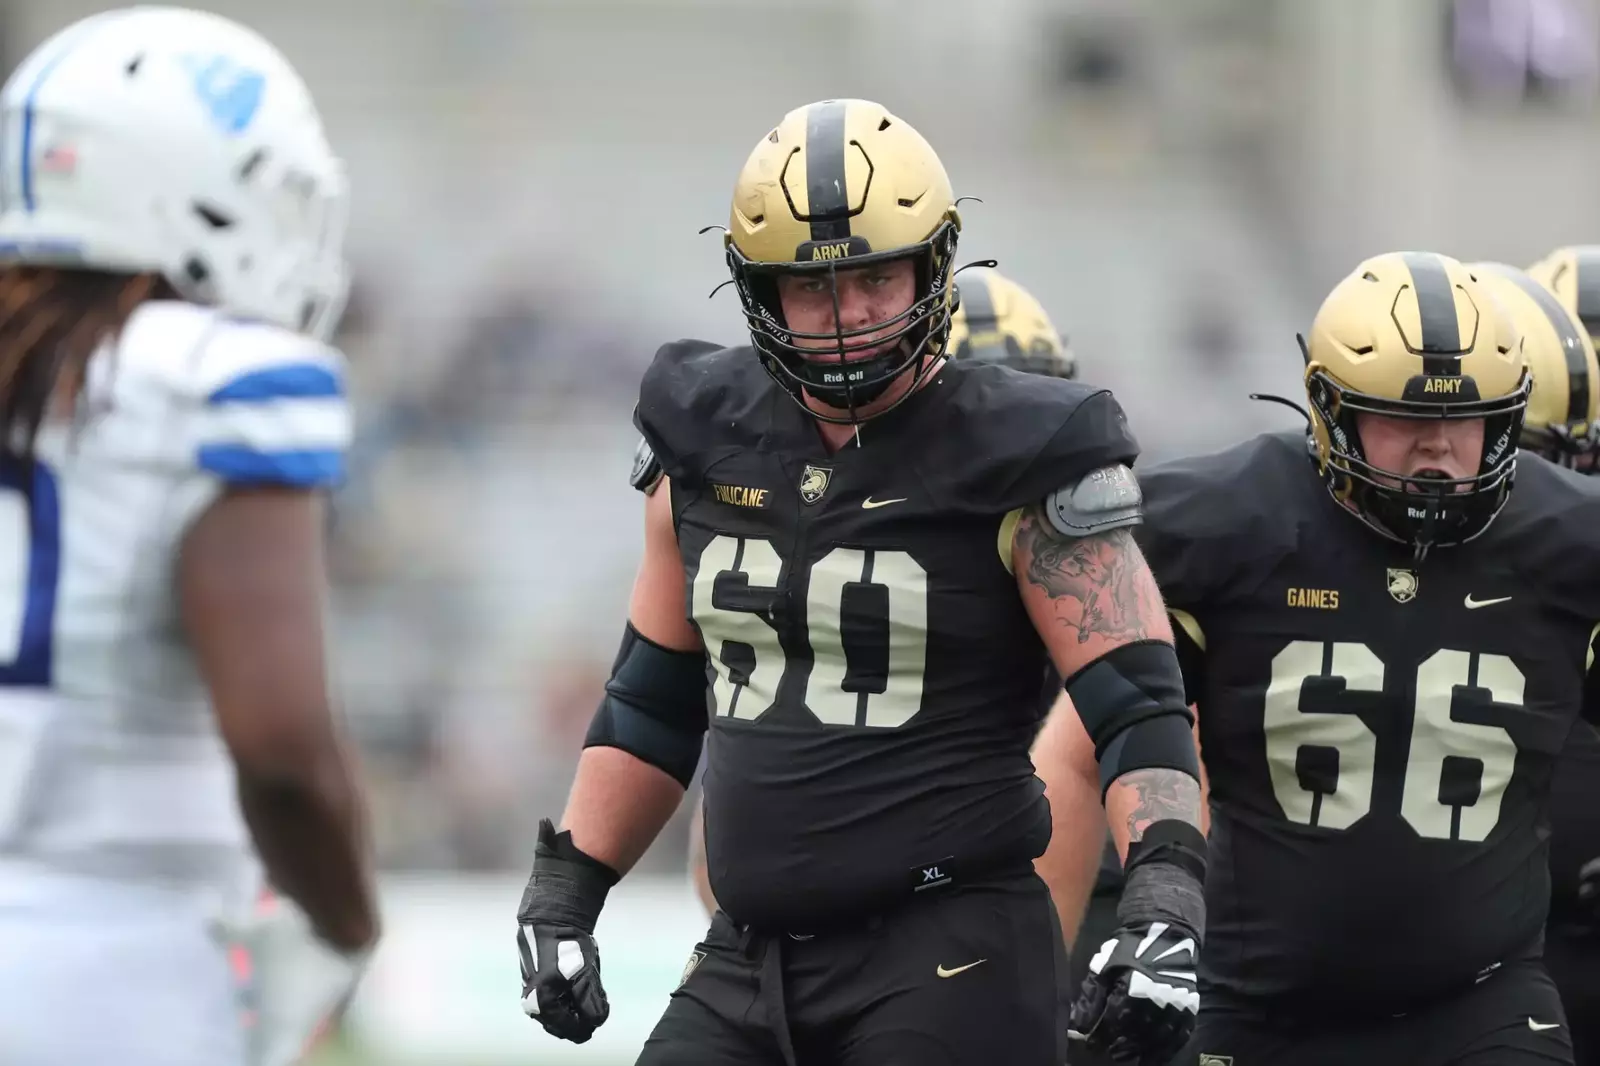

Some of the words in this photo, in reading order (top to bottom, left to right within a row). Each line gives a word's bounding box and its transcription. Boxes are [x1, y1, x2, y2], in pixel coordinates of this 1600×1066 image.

[812, 242, 851, 261] ARMY
[1423, 377, 1463, 394] ARMY
[1287, 587, 1340, 609] GAINES
[692, 534, 928, 728] 60
[1263, 639, 1526, 843] 66
[922, 866, 945, 882] XL
